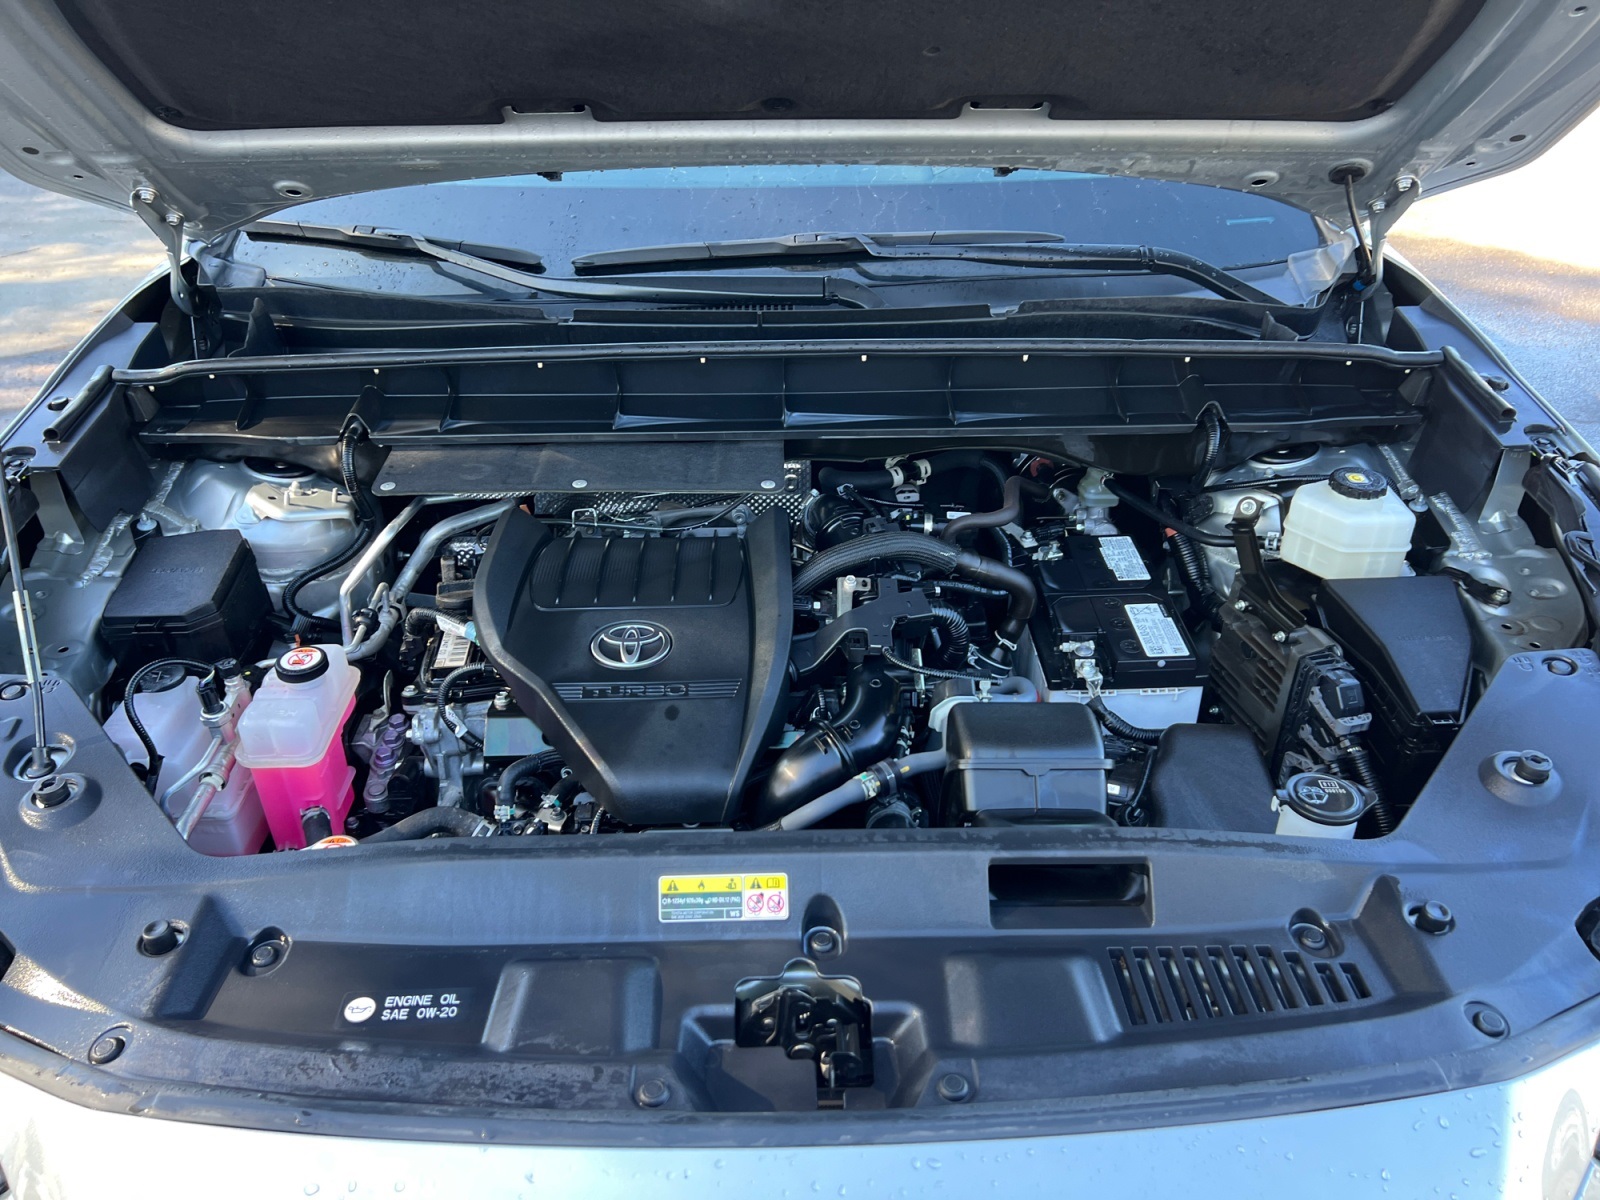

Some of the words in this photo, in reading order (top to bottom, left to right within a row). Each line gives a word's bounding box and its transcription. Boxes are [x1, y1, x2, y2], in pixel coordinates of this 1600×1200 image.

[583, 684, 688, 697] TURBO
[384, 994, 433, 1007] ENGINE
[439, 994, 460, 1005] OIL
[381, 1008, 409, 1021] SAE
[416, 1006, 458, 1019] 0W-20
